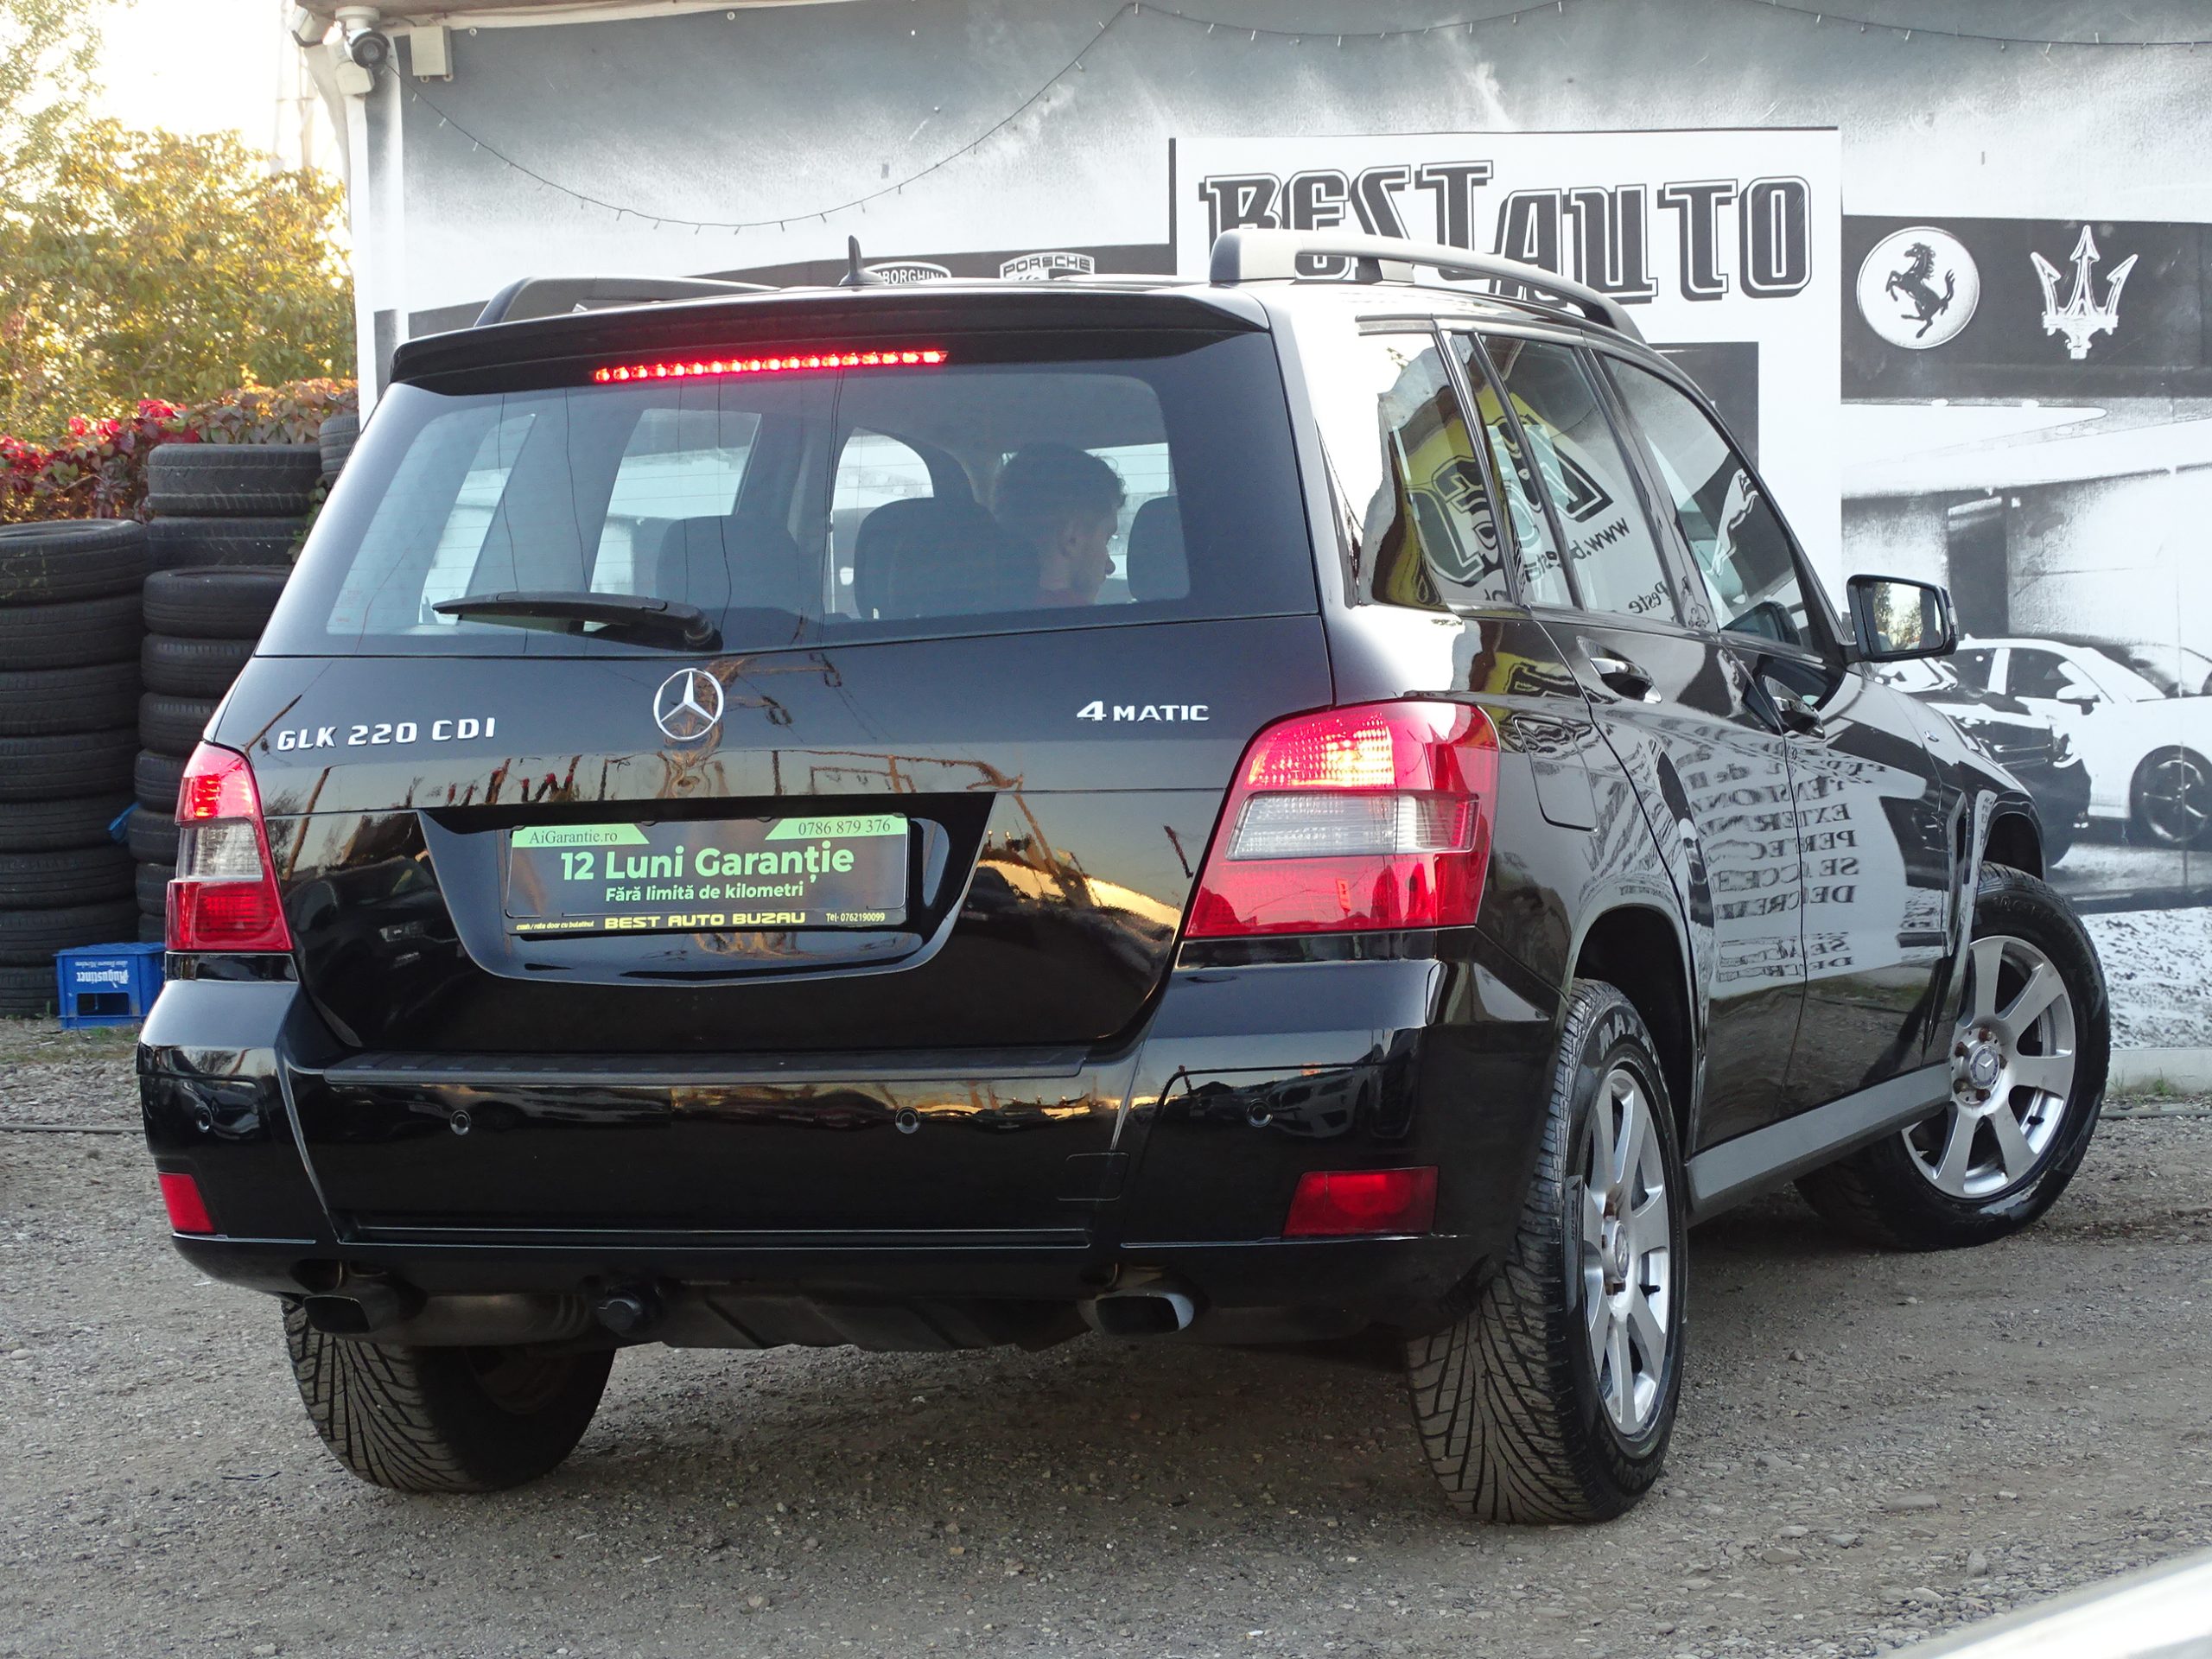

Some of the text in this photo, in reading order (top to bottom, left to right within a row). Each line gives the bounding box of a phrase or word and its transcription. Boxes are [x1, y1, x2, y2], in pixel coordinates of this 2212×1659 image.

[1003, 255, 1091, 277] PORSCHE
[276, 717, 495, 751] GLK 220 CDI
[529, 830, 618, 843] AiGarantie.ro
[798, 818, 891, 836] 0786 879 376
[561, 840, 855, 883] 12 Luni Garanție
[606, 880, 804, 902] Fără limită de kilometri
[605, 912, 805, 930] BEST AUTO BUZAU
[840, 912, 886, 923] 0762190099
